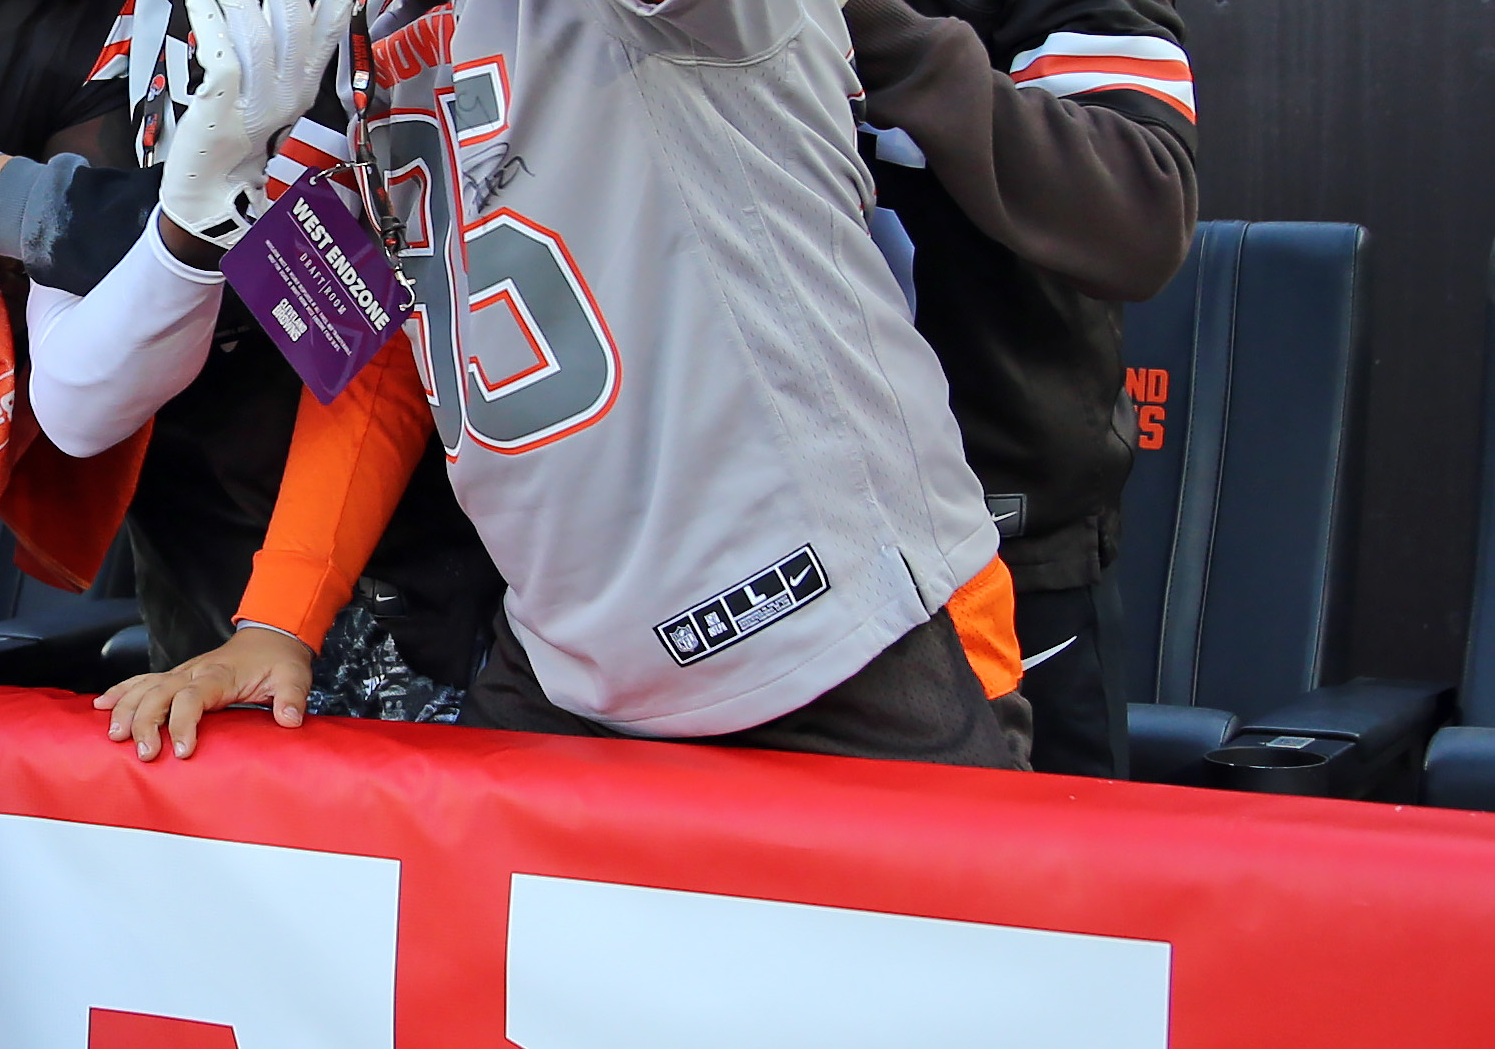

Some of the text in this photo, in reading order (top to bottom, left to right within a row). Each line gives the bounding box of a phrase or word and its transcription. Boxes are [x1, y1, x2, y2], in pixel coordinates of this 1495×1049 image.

[292, 196, 334, 250] WEST
[325, 243, 391, 332] ENDZONE
[743, 584, 768, 607] L
